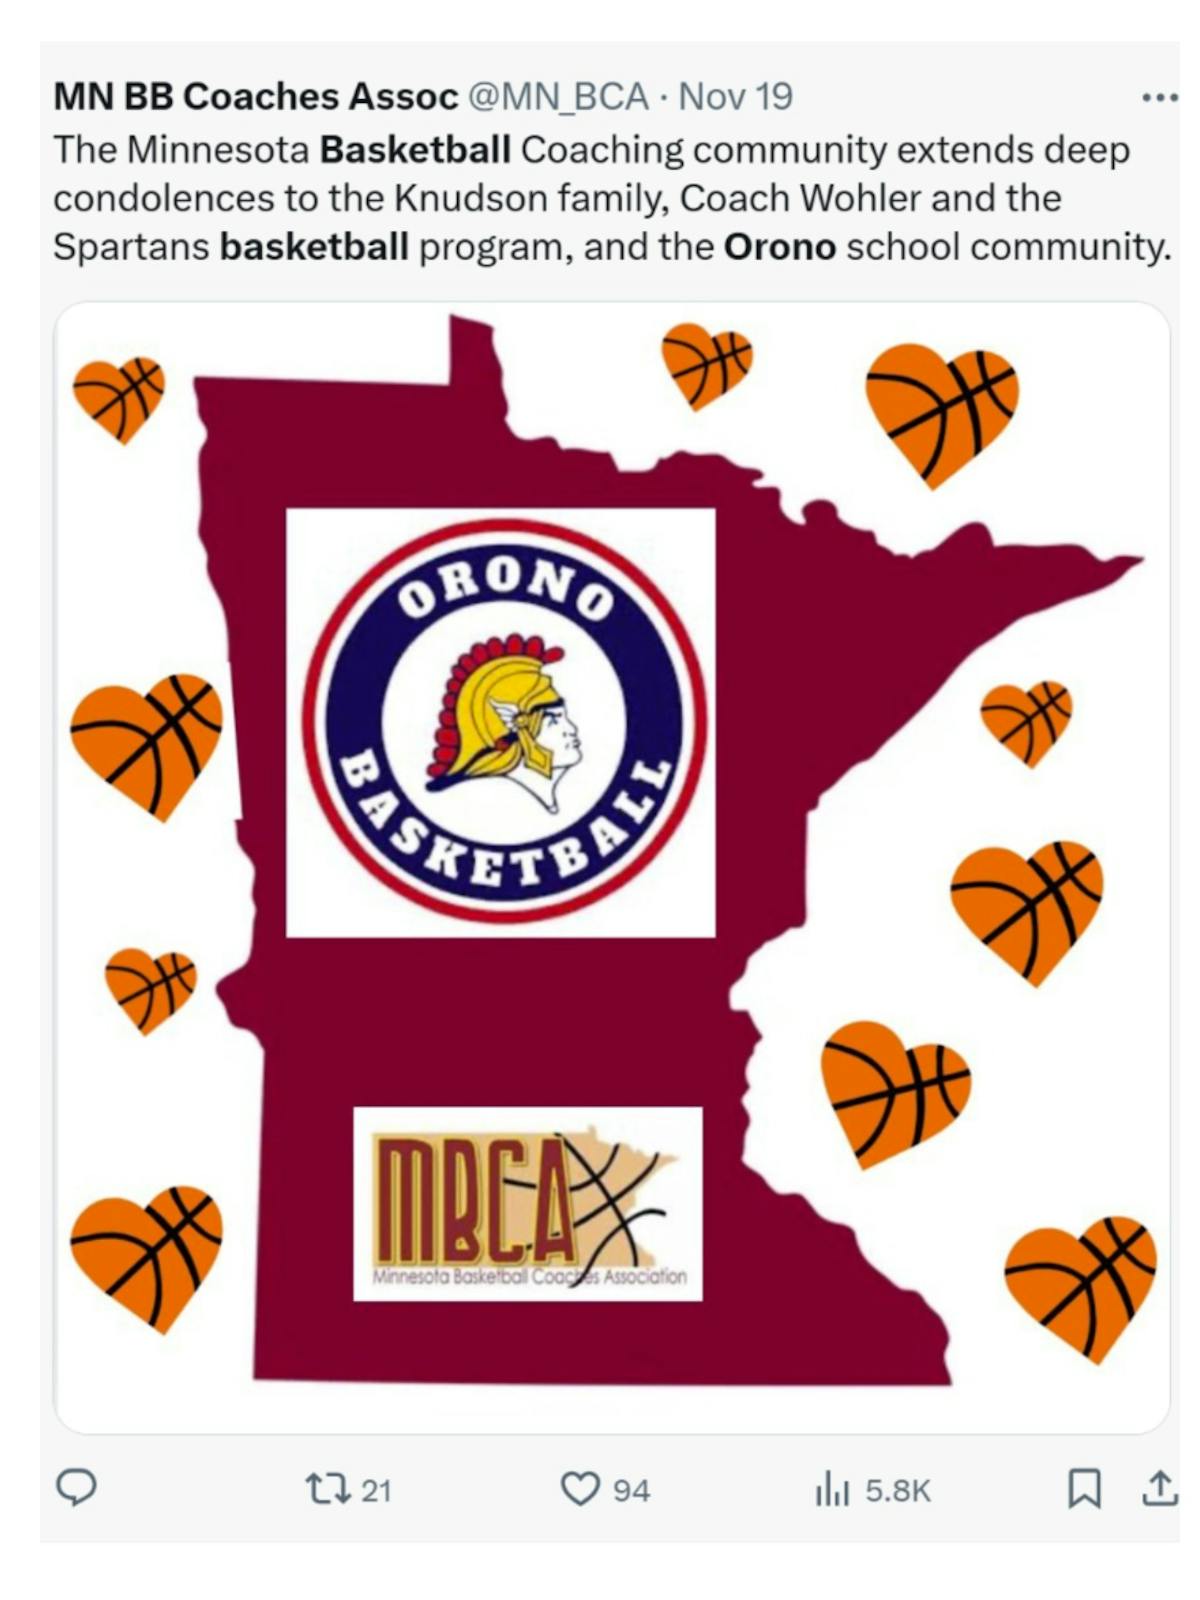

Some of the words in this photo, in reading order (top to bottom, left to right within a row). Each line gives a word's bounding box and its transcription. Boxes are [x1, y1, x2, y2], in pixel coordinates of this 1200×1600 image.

[54, 80, 114, 111] MN
[124, 80, 174, 111] BB
[183, 80, 340, 111] Coaches
[347, 80, 460, 111] Assoc
[468, 81, 650, 117] @MN_BCA
[680, 81, 747, 111] Nov
[756, 81, 793, 111] 19
[52, 133, 118, 164] The
[128, 133, 309, 164] Minnesota
[320, 133, 511, 164] Basketball
[521, 133, 685, 171] Coaching
[693, 133, 889, 171] community
[897, 133, 1035, 164] extends
[1044, 133, 1131, 171] deep
[53, 181, 275, 213] condolences
[283, 184, 319, 213] to
[327, 181, 385, 213] the
[395, 181, 548, 213] Knudson
[556, 181, 669, 220] family,
[680, 181, 790, 213] Coach
[799, 181, 923, 213] Wohler
[931, 181, 995, 213] and
[1004, 181, 1062, 213] the
[53, 231, 210, 268] Spartans
[220, 230, 409, 261] basketball
[420, 235, 574, 269] program,
[584, 230, 648, 261] and
[657, 230, 715, 261] the
[723, 231, 837, 261] Orono
[847, 230, 960, 261] school
[970, 230, 1172, 268] community.
[397, 554, 615, 622] ORONO
[339, 747, 672, 887] BASKETBALL
[378, 1138, 576, 1264] MBCA
[372, 1267, 450, 1286] Minnesota
[453, 1267, 529, 1286] Basketball
[532, 1267, 600, 1286] Coaches
[603, 1267, 688, 1286] Association
[362, 1478, 390, 1503] 21
[613, 1478, 651, 1503] 94
[866, 1478, 932, 1503] 5.8K
